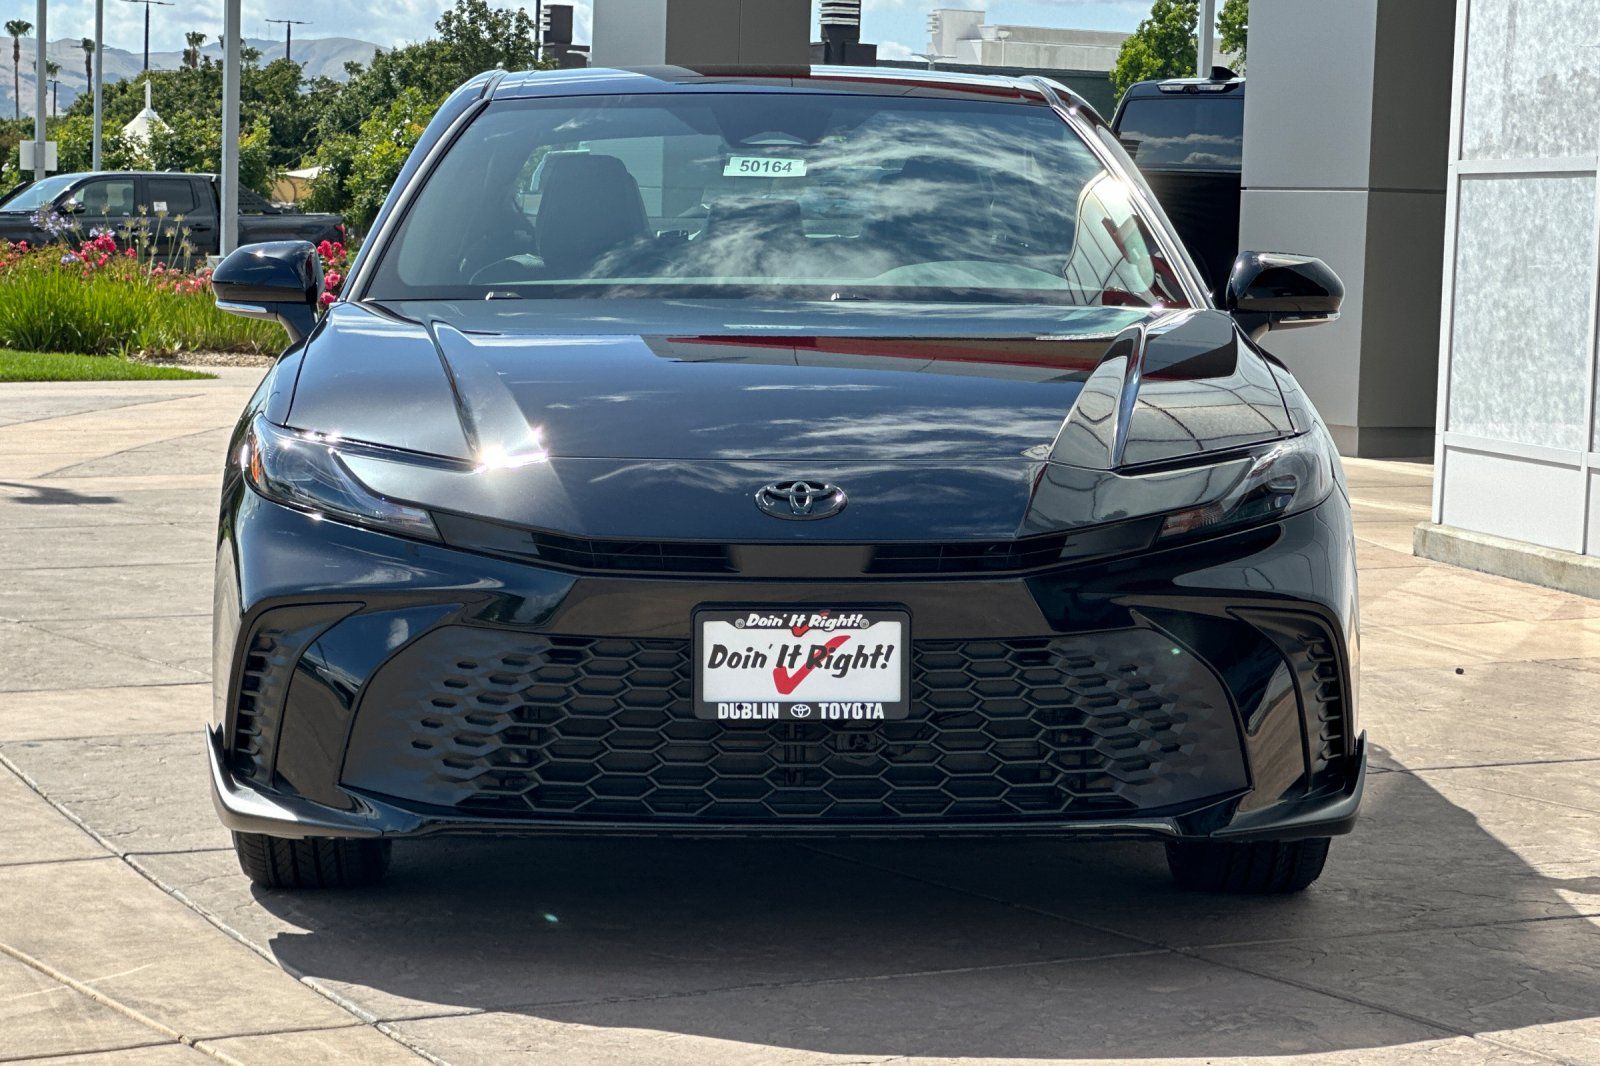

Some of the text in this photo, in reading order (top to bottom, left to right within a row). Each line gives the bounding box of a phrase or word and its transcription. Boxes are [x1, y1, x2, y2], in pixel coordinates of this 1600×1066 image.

[740, 160, 792, 172] 50164
[746, 613, 863, 632] Doin' It Right!
[707, 644, 895, 678] Doin' It Right!
[718, 702, 884, 720] DUBLIN TOYOTA
